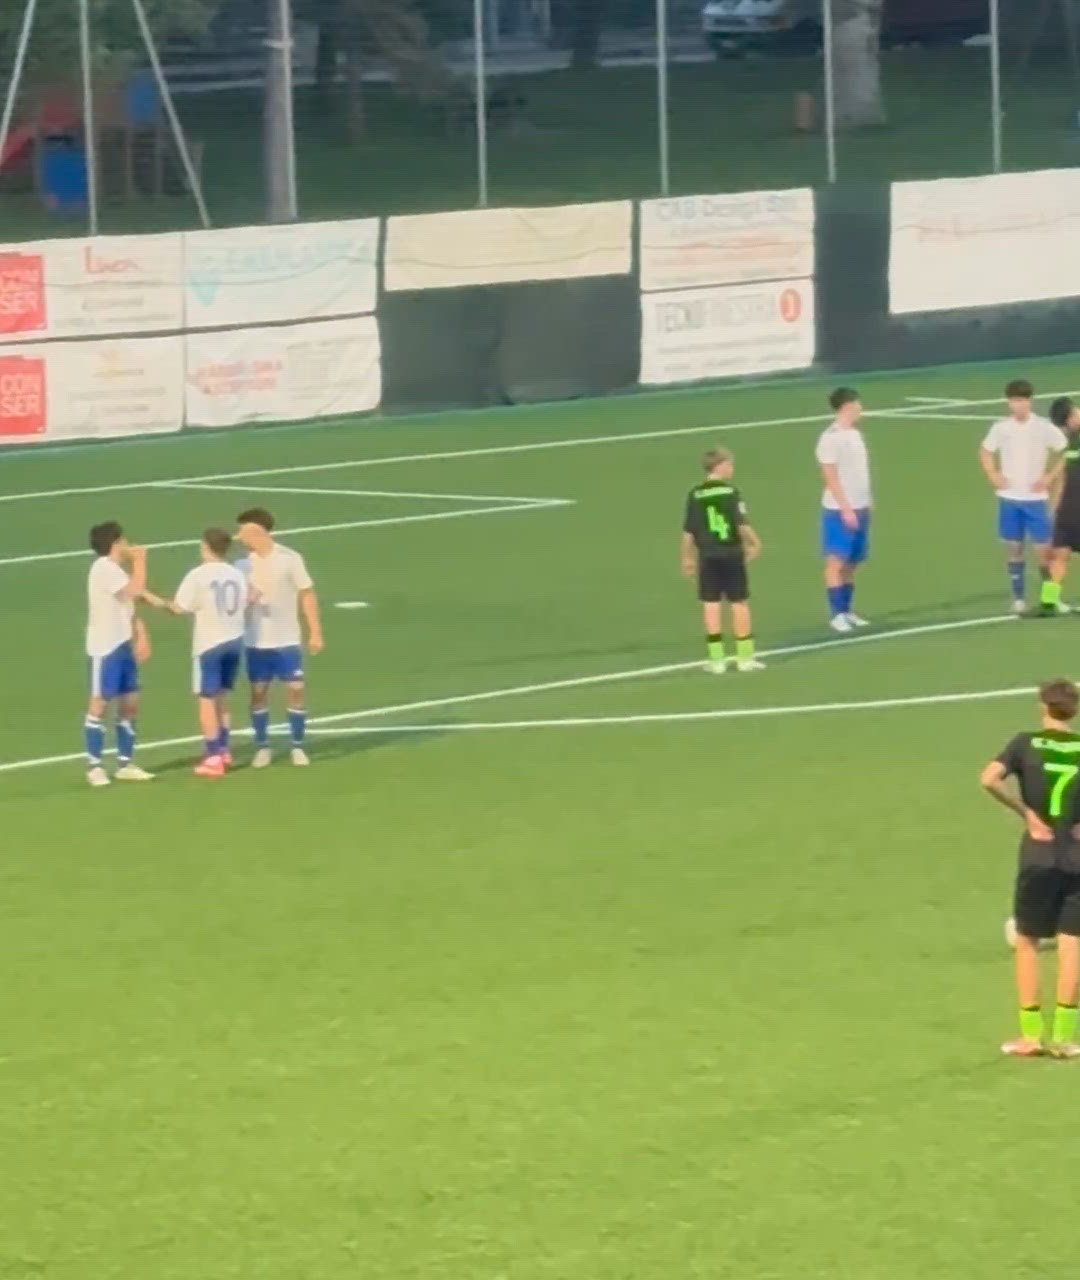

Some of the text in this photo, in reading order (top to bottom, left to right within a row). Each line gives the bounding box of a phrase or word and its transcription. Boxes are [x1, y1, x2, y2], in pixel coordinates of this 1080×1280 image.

[0, 291, 42, 315] SER
[0, 373, 42, 397] CON
[0, 395, 42, 418] SER
[706, 505, 730, 540] 4
[209, 578, 242, 618] 10
[1042, 762, 1079, 816] 7
